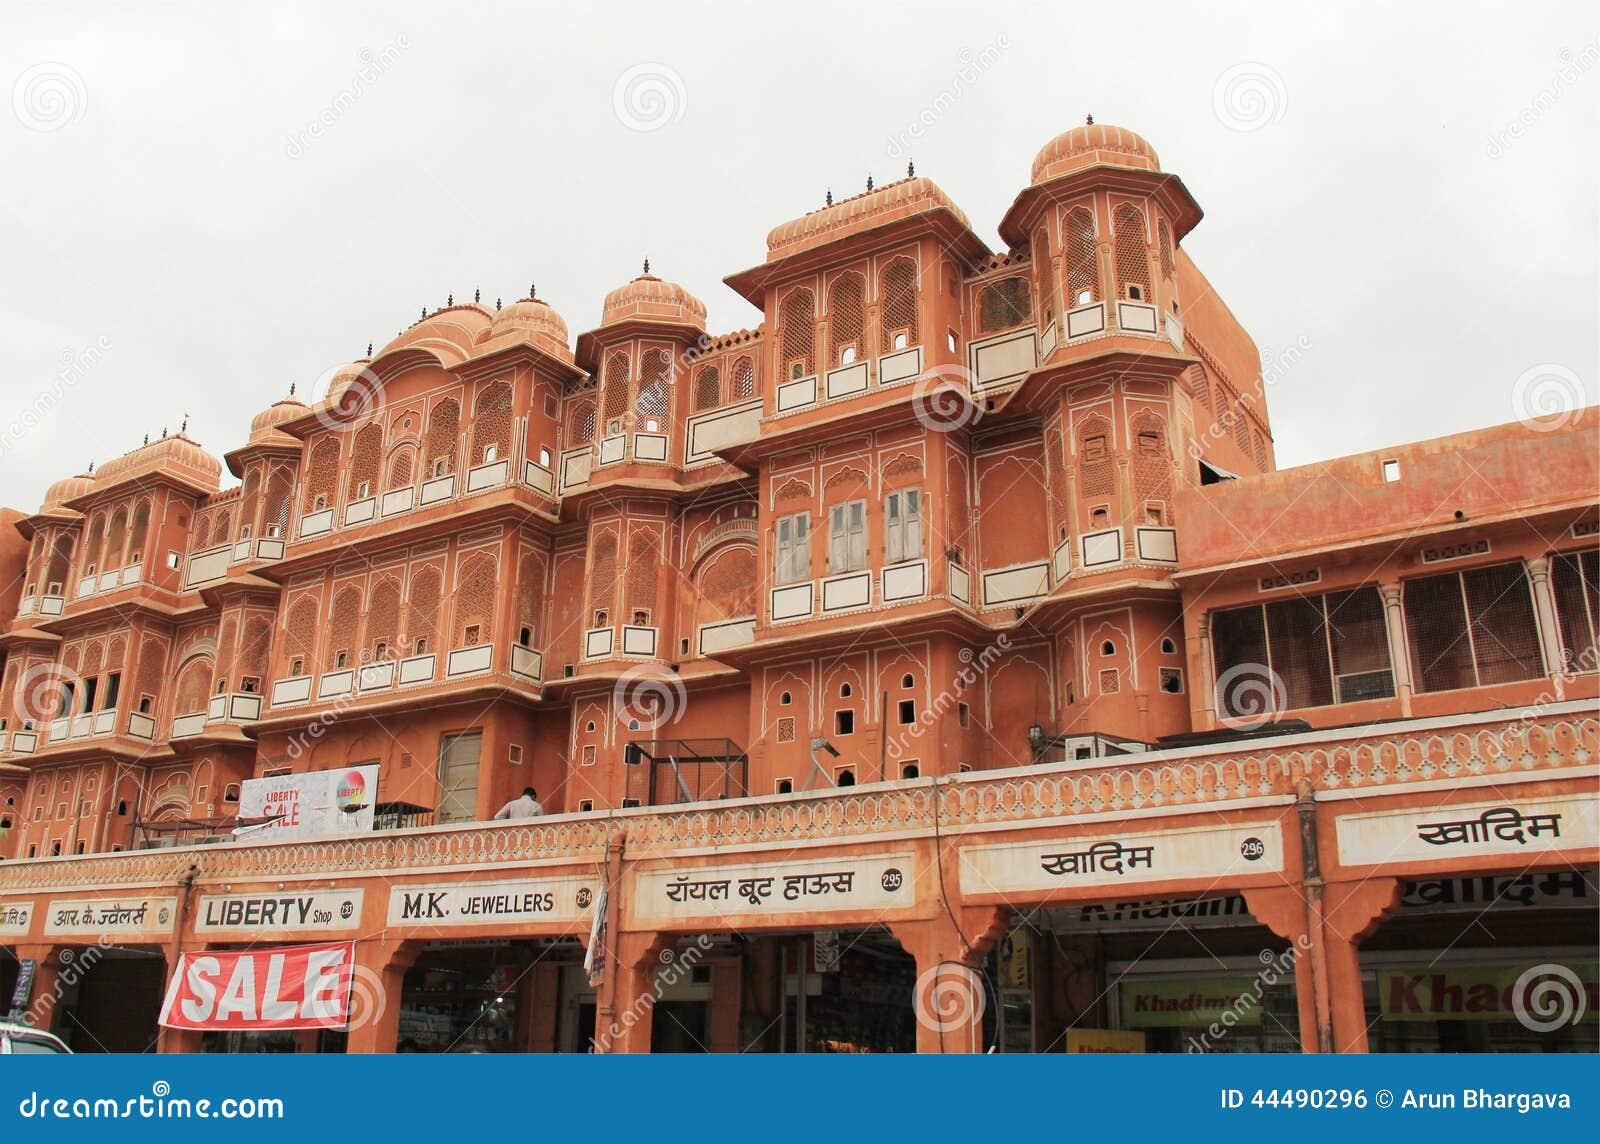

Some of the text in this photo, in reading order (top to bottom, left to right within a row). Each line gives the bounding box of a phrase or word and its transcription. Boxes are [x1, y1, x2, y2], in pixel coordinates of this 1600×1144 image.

[266, 788, 300, 803] LIBERTY
[1416, 807, 1562, 845] खादिम
[1040, 841, 1264, 875] खादिम 296
[402, 890, 593, 918] M.K. JEWELLERS 294
[666, 871, 901, 905] रॉयल बूट हाऊस 295
[205, 897, 314, 926] LIBERTY
[313, 909, 333, 925] Shop
[181, 950, 345, 1022] SALE
